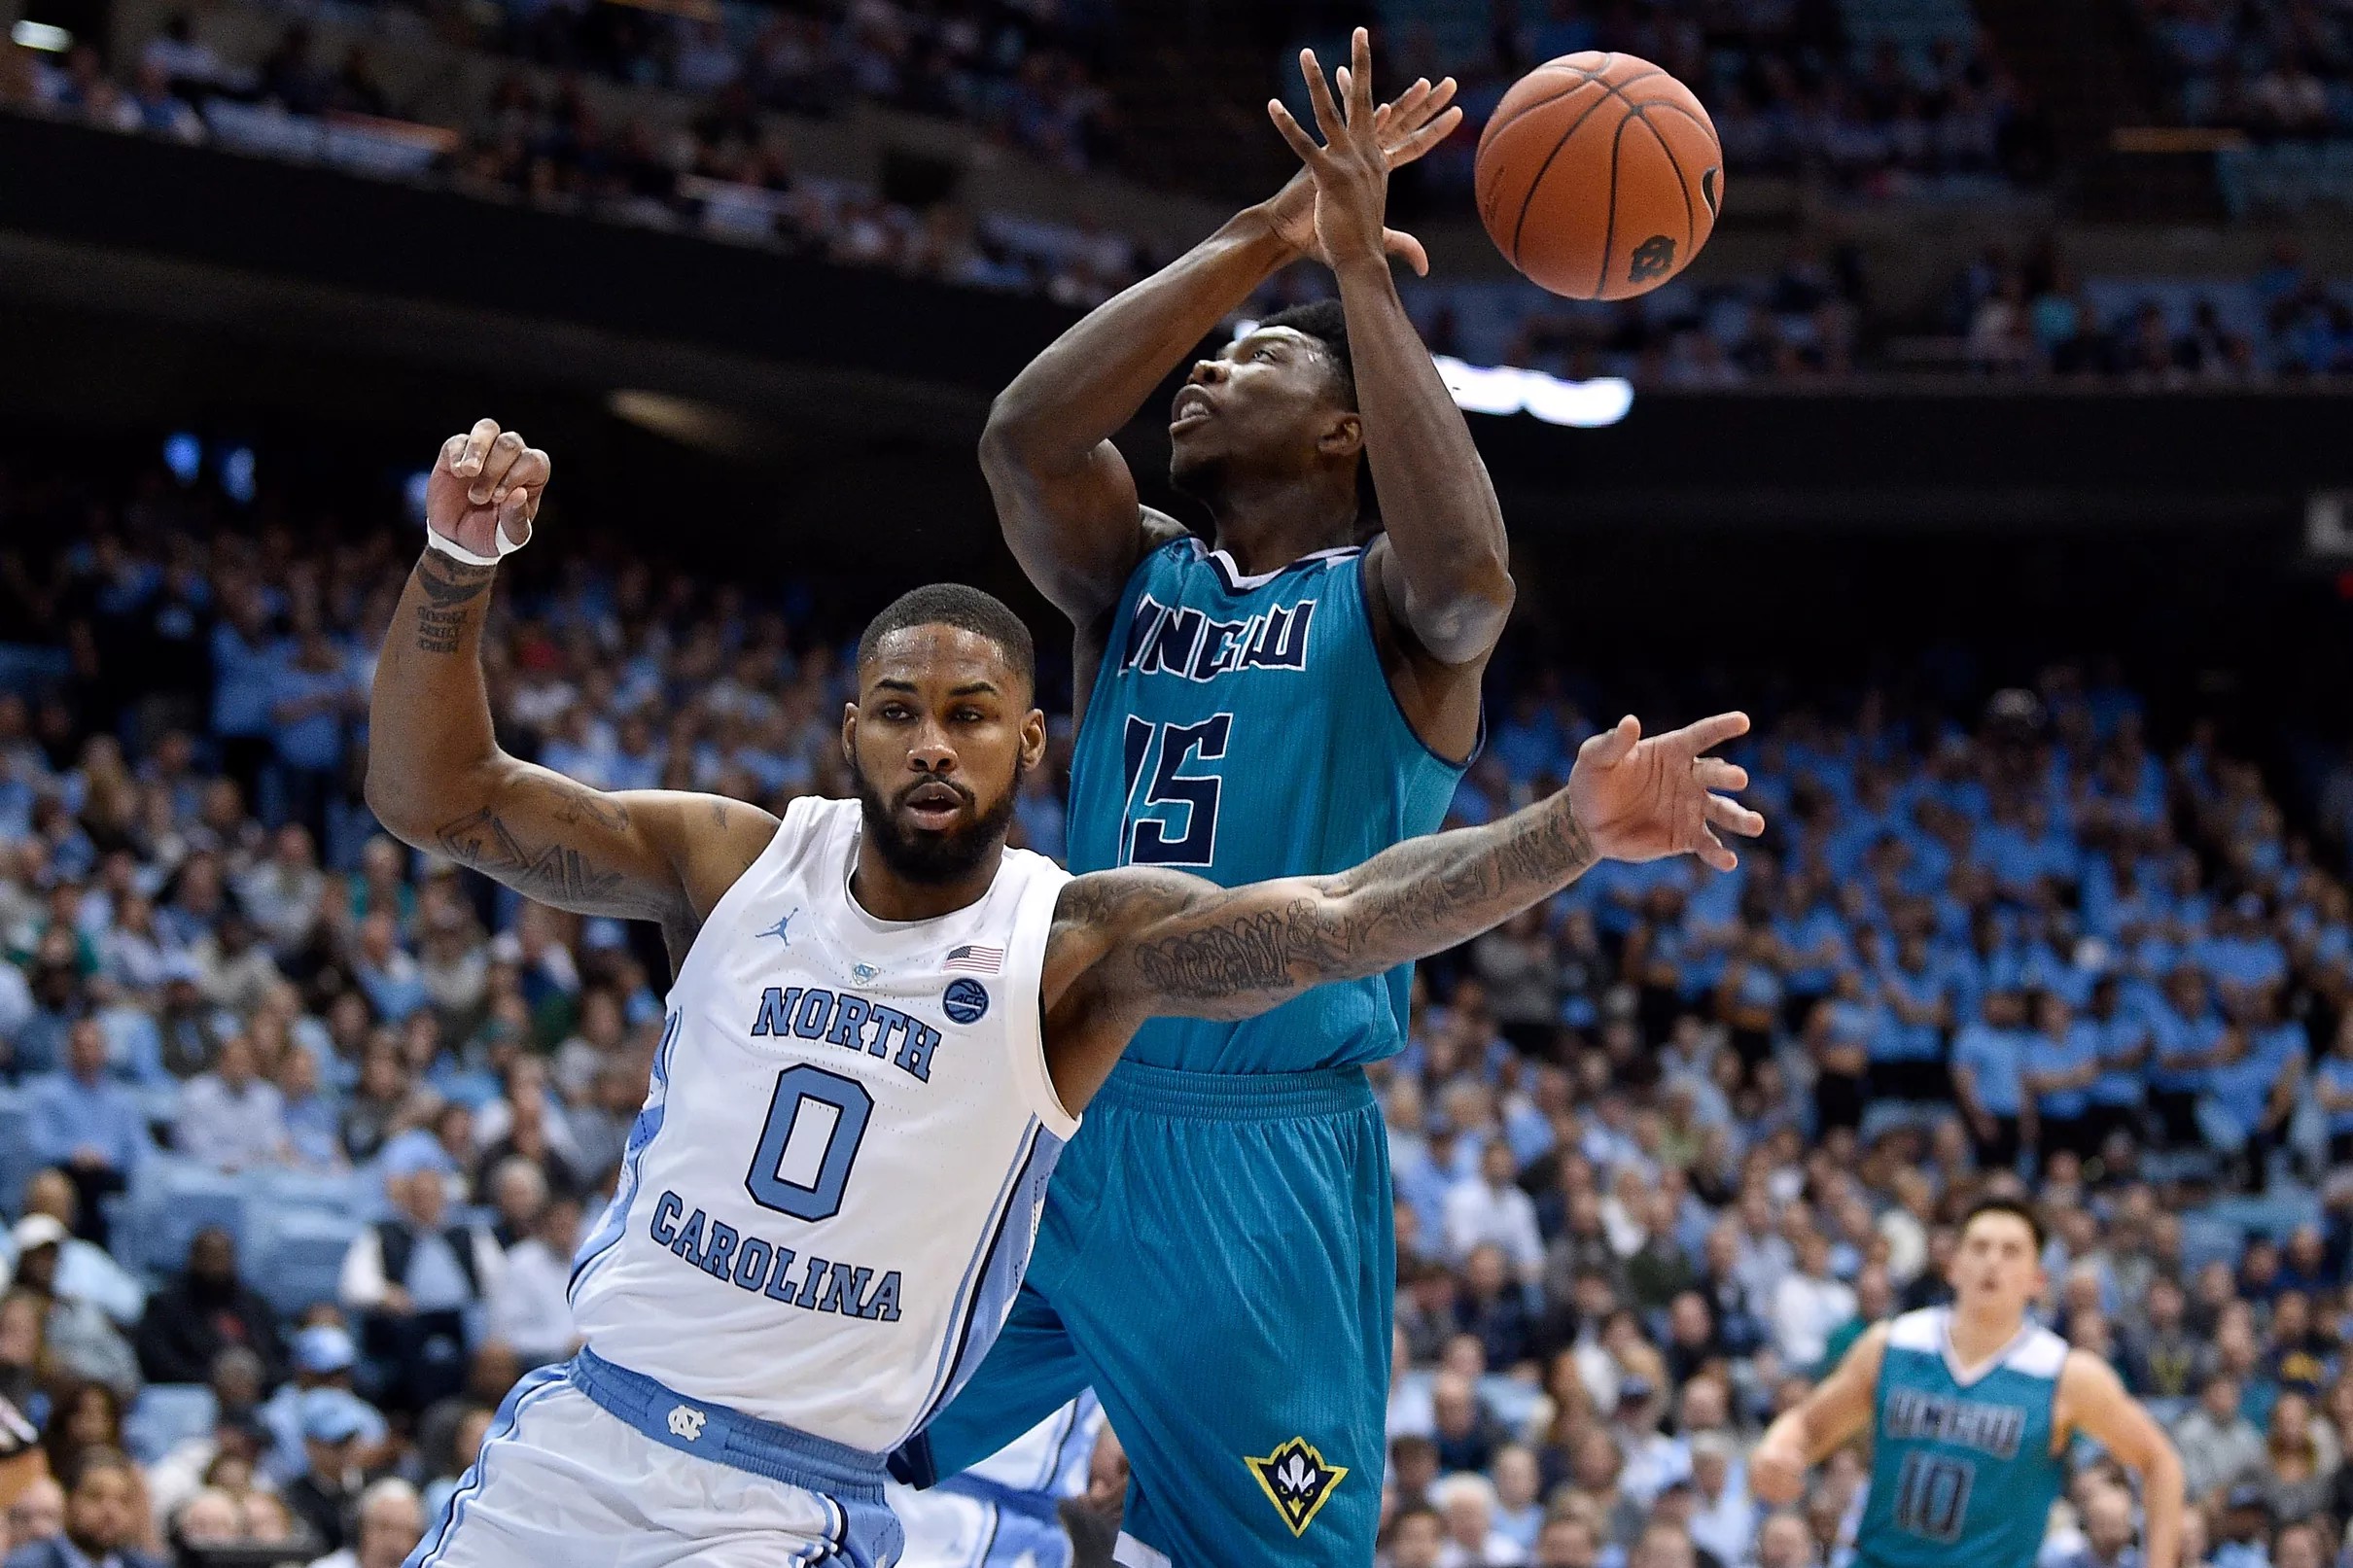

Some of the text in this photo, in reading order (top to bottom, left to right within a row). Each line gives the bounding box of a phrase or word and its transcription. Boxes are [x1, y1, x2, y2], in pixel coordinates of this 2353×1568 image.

[1118, 713, 1233, 867] 15
[751, 987, 941, 1084] NORTH
[745, 1063, 874, 1222] 0
[650, 1190, 902, 1322] CAROLINA
[1897, 1448, 1975, 1544] 10
